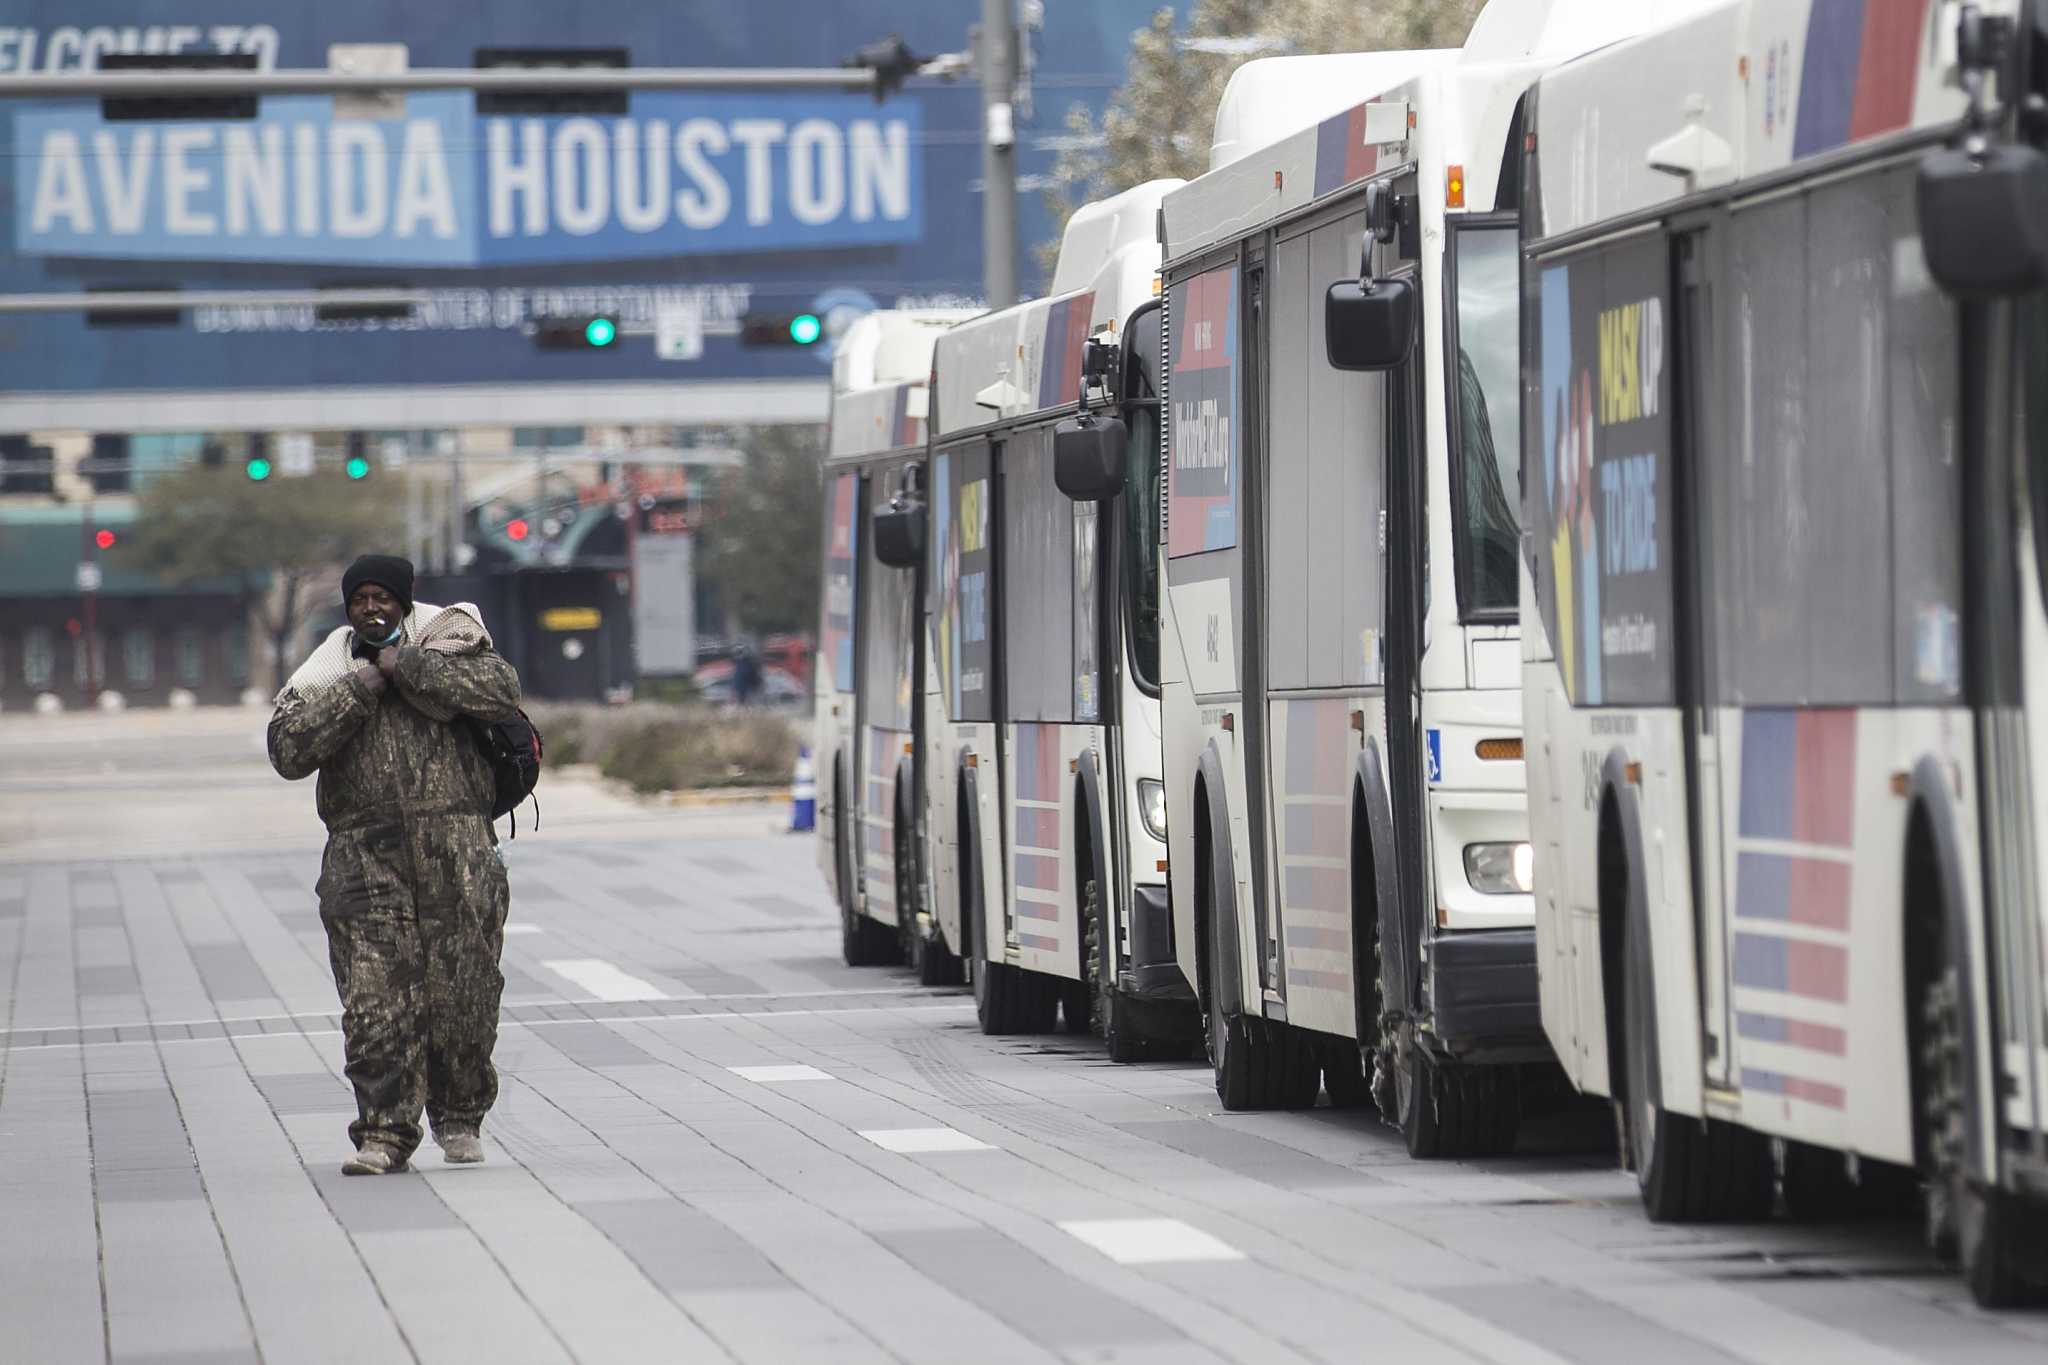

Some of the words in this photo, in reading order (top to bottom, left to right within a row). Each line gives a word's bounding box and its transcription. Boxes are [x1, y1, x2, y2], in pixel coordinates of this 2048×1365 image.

[33, 119, 457, 238] AVENIDA
[489, 118, 910, 236] HOUSTON
[1600, 305, 1641, 424] MASK
[1642, 297, 1662, 416] UP
[1601, 460, 1622, 575] TO
[1625, 454, 1657, 572] RIDE
